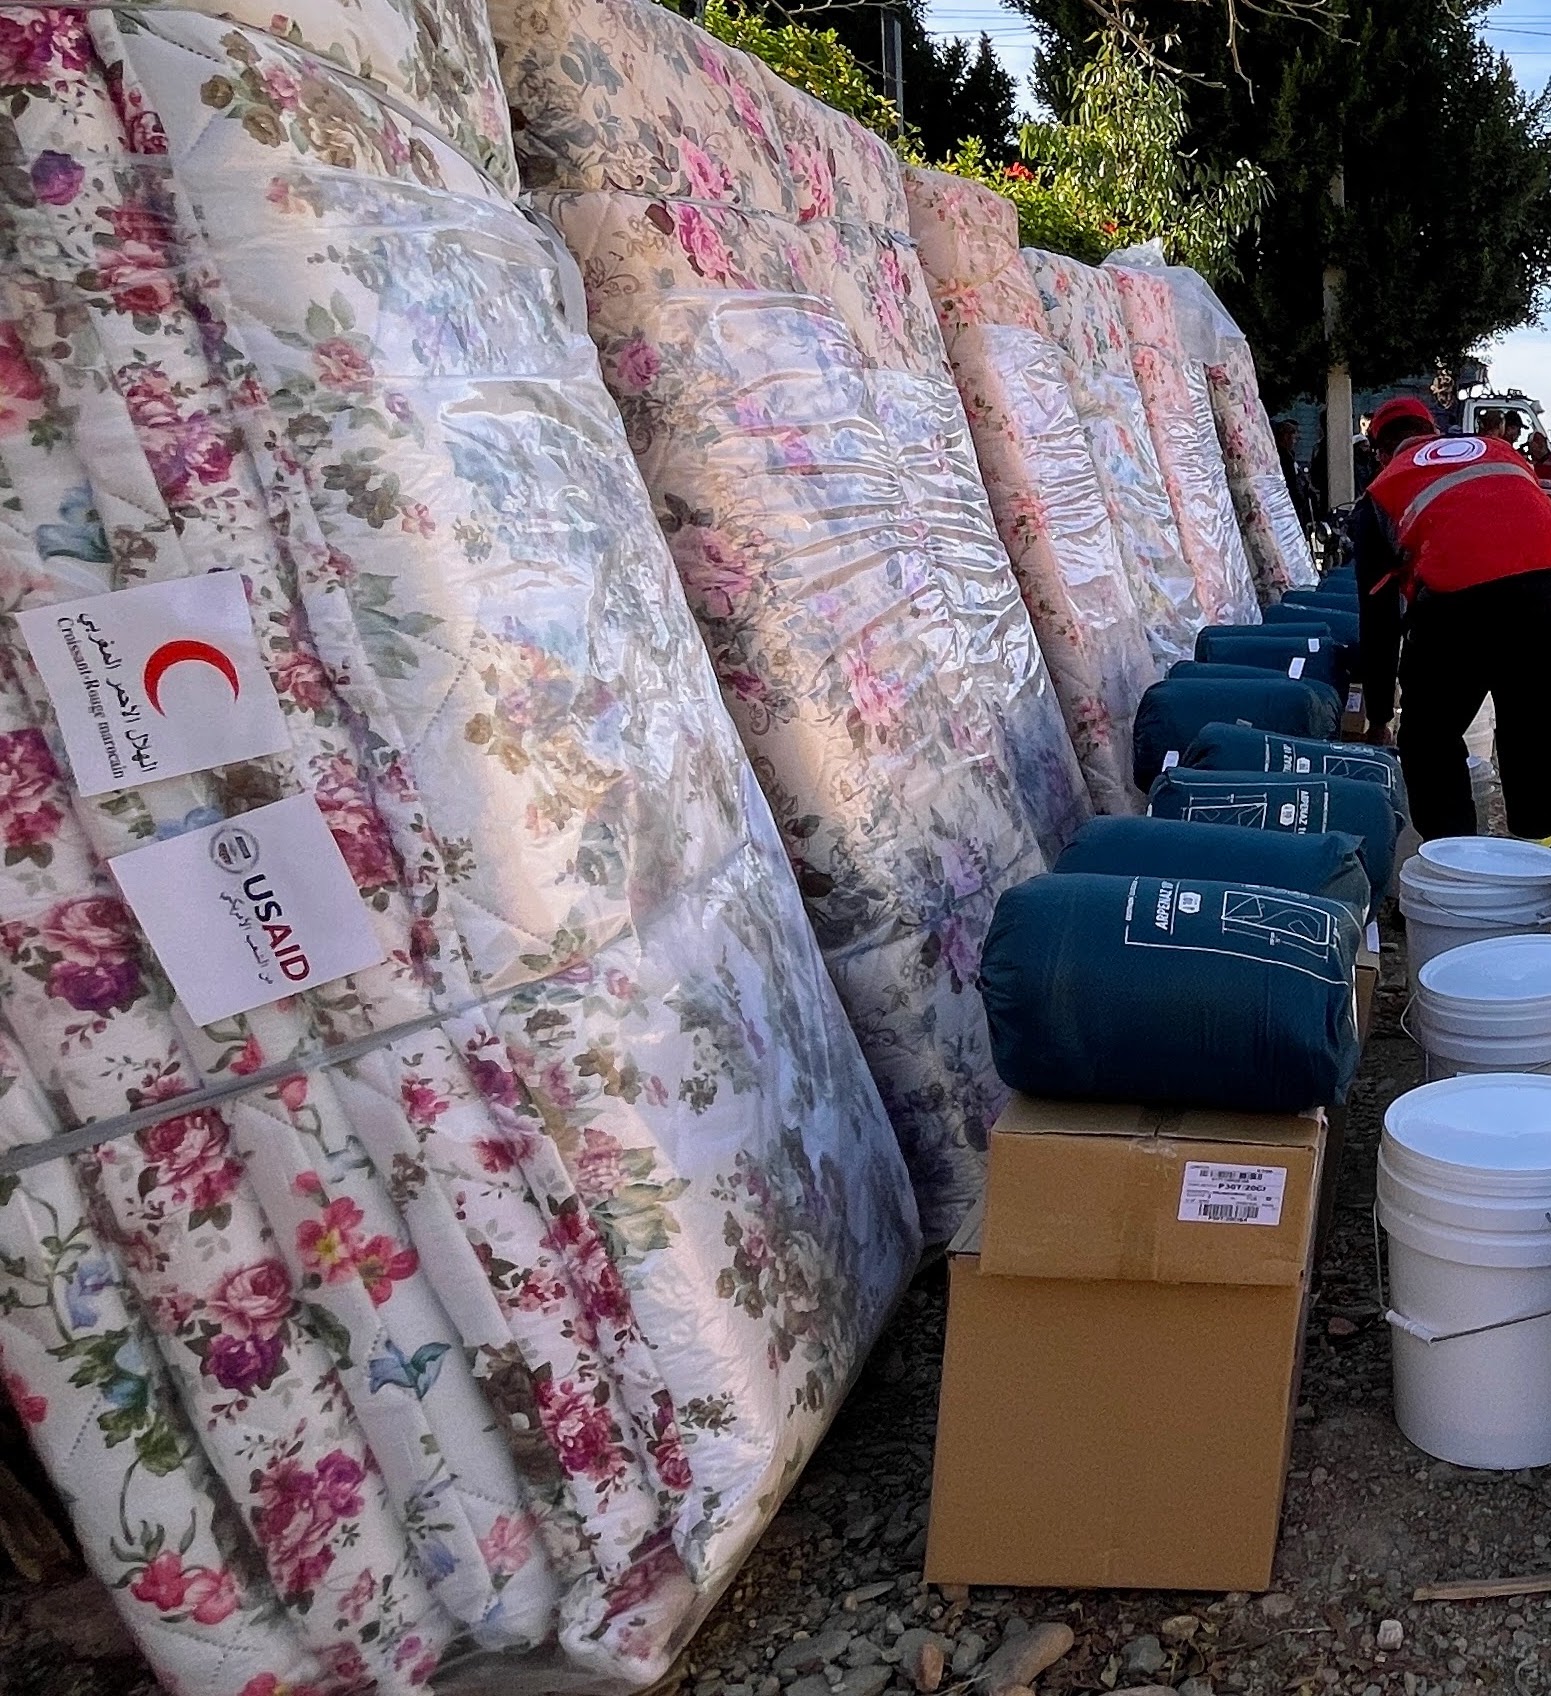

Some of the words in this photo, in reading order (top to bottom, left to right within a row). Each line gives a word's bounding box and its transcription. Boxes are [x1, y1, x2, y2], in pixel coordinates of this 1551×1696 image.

[77, 612, 121, 669] المغربي
[57, 616, 105, 718] Croissant-Rouge
[98, 719, 124, 779] marocain
[124, 727, 158, 773] الهلال
[242, 873, 311, 983] USAID
